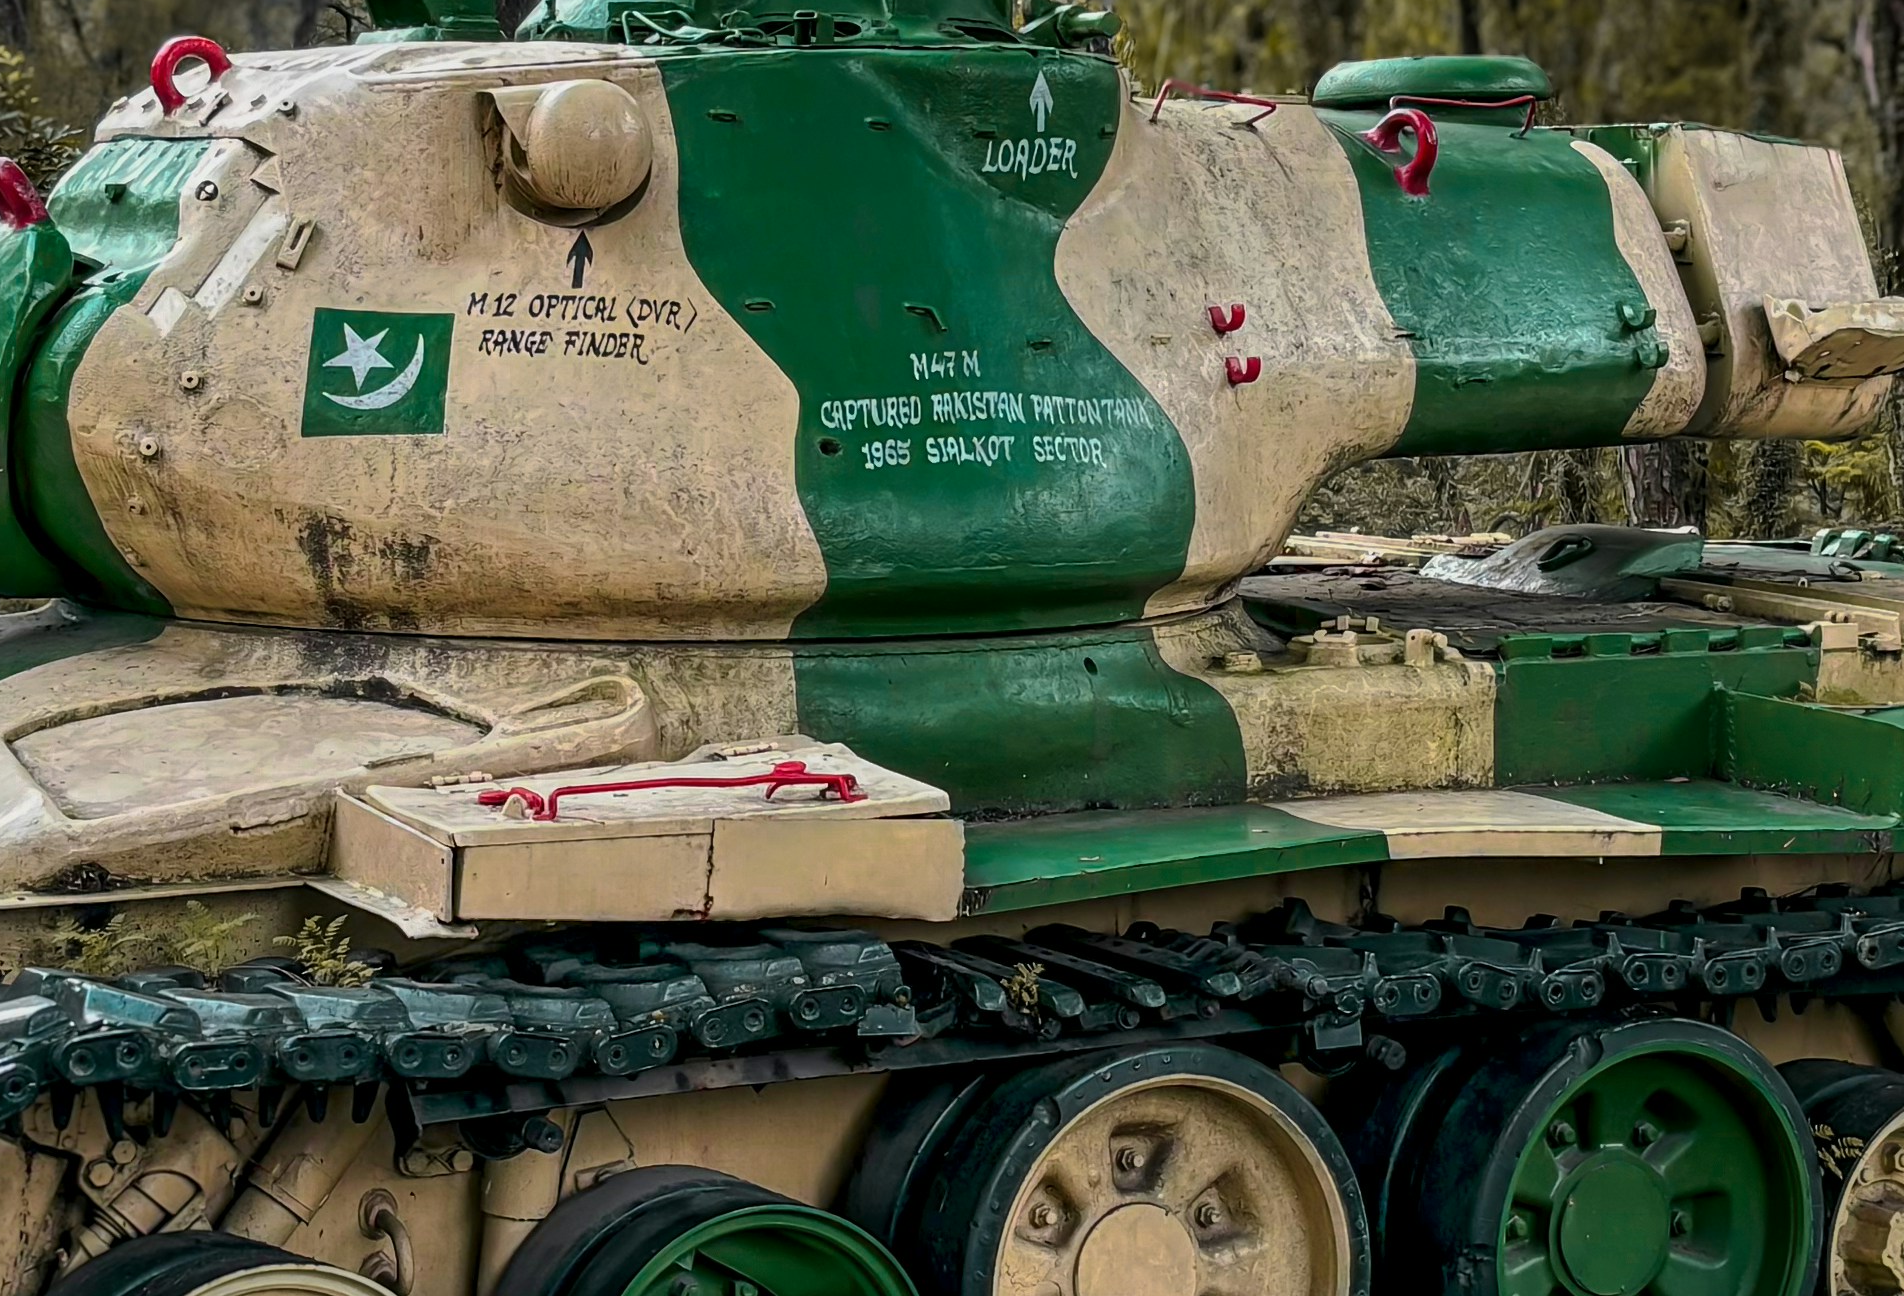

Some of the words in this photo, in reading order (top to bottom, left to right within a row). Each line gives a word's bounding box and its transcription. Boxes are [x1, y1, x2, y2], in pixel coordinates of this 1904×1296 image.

[981, 137, 1079, 182] LOADER
[528, 294, 617, 323] OPTICAL
[478, 329, 553, 357] RANGE
[563, 330, 649, 365] FINDER
[820, 395, 922, 431] CAPTURED
[861, 438, 911, 470] 1965
[925, 435, 1015, 467] SIALKOT
[1032, 434, 1108, 469] SECTOR
